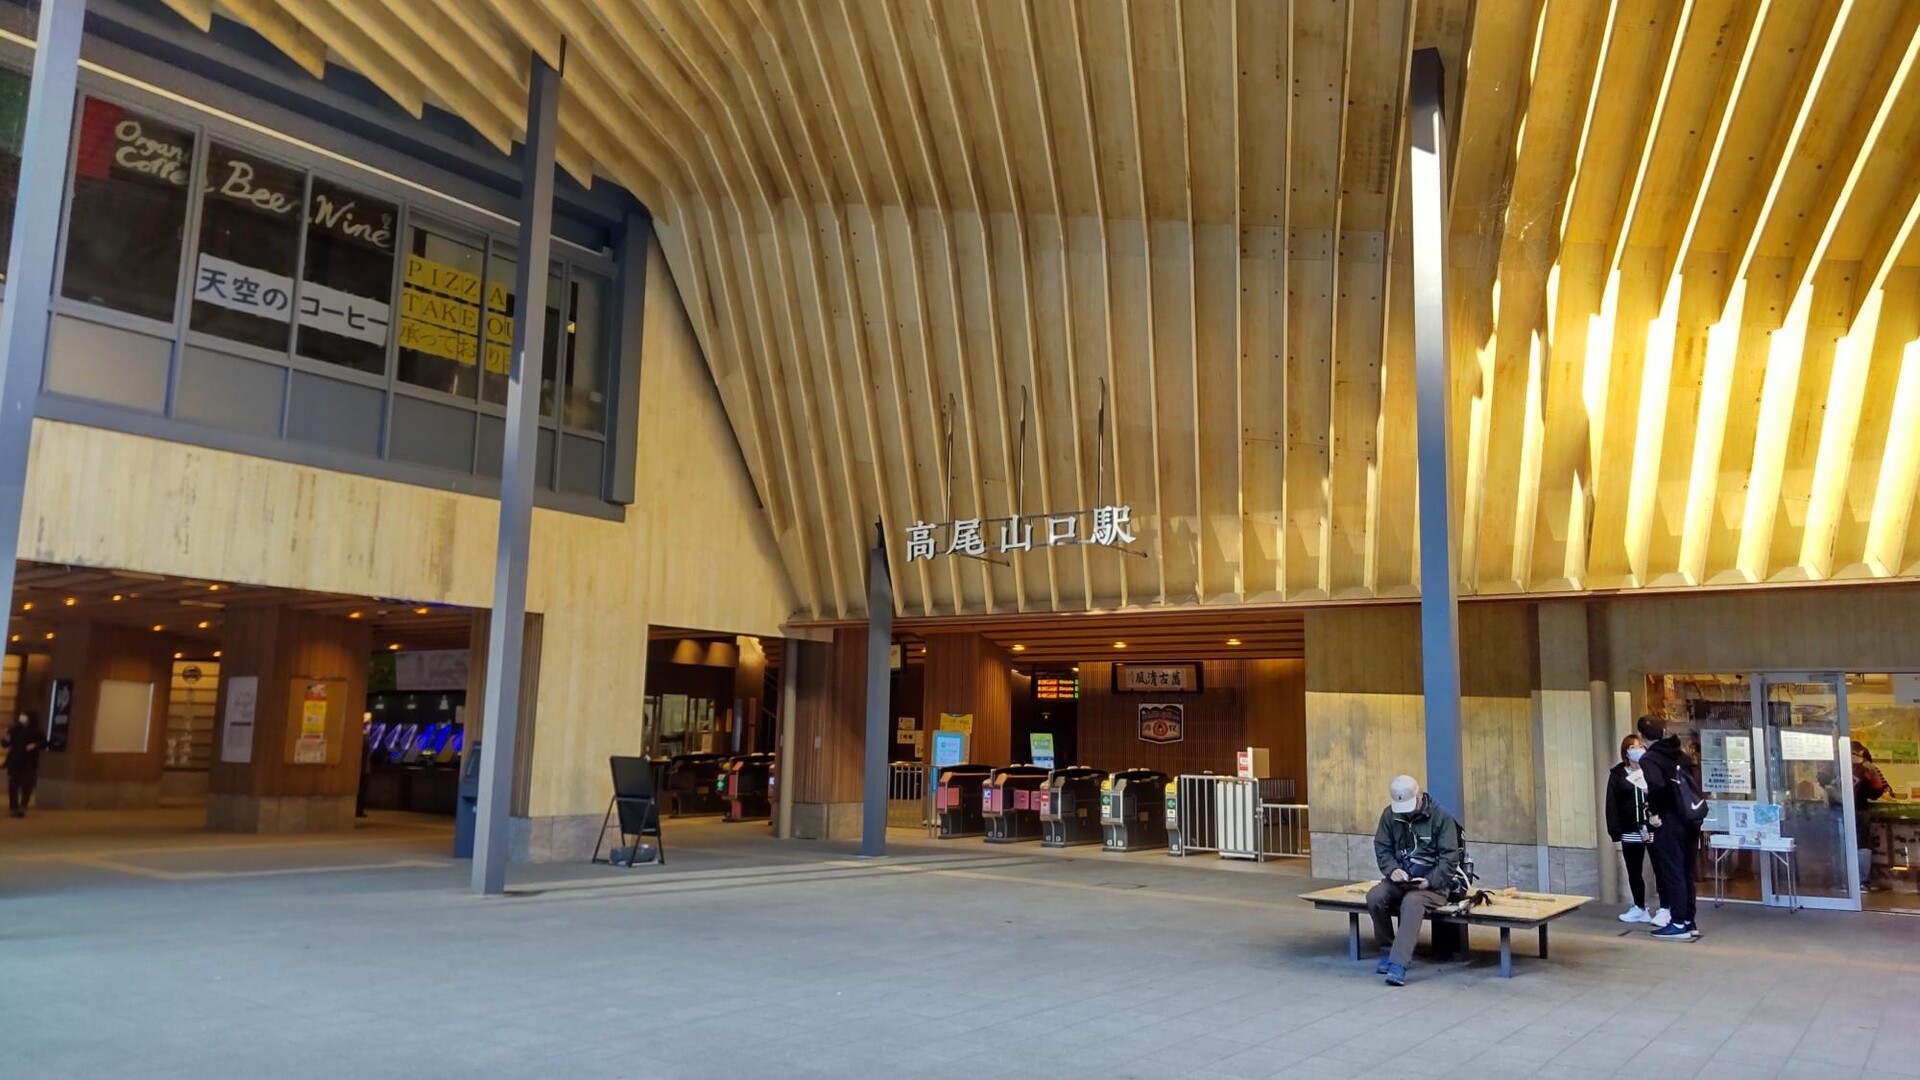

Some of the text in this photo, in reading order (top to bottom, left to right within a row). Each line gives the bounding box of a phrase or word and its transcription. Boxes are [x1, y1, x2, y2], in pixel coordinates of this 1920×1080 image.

[315, 194, 393, 248] Wine
[408, 260, 505, 306] PIZZA
[905, 505, 1137, 563] 高尾山口駅
